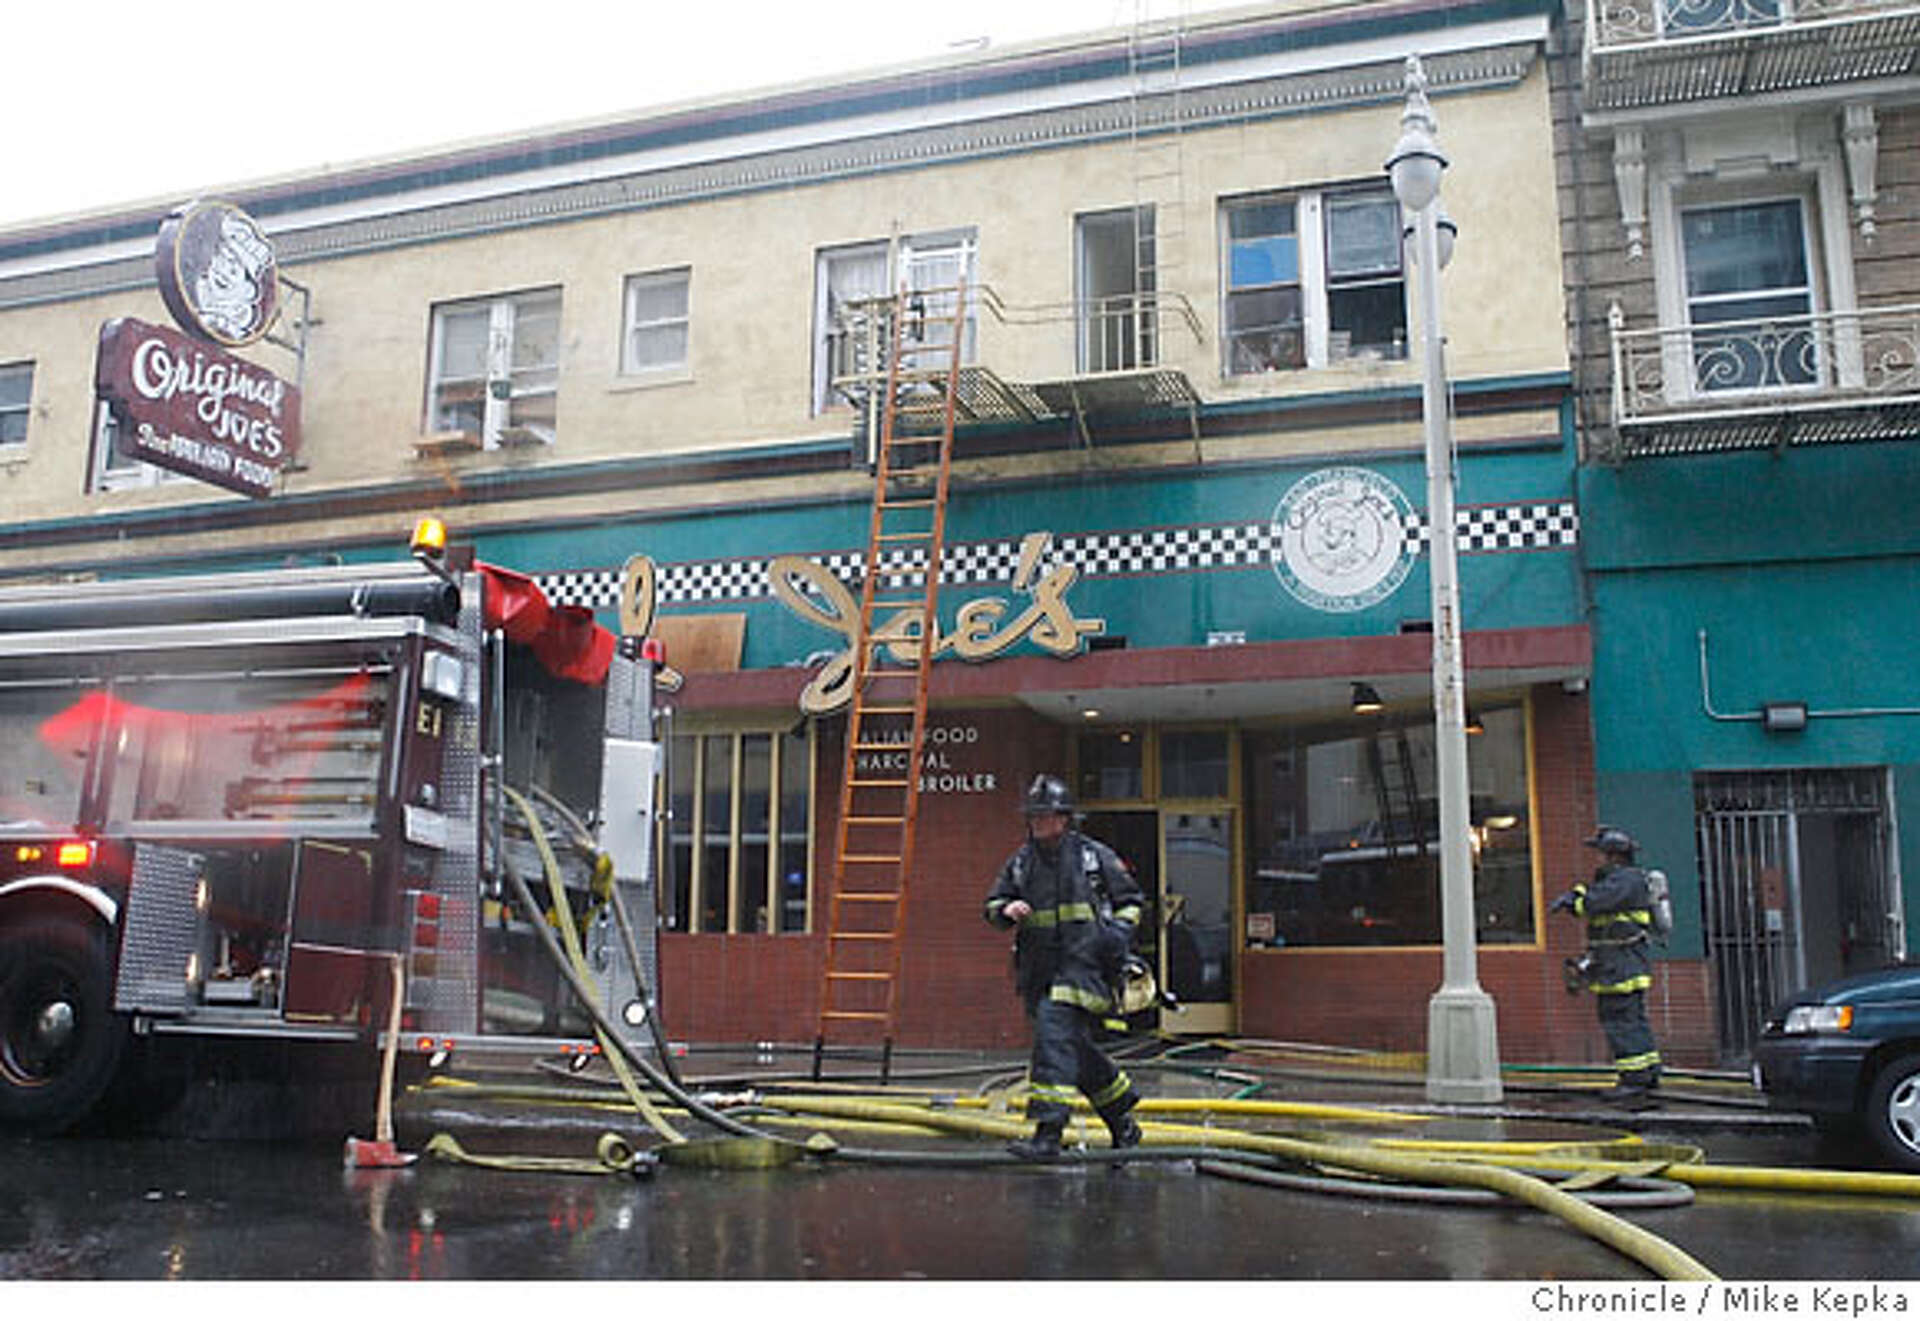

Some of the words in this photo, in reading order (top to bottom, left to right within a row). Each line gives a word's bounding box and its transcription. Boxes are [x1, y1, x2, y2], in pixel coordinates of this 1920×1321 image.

[132, 339, 284, 422] Original
[212, 409, 282, 458] JOE'S
[768, 531, 1103, 713] Joe's
